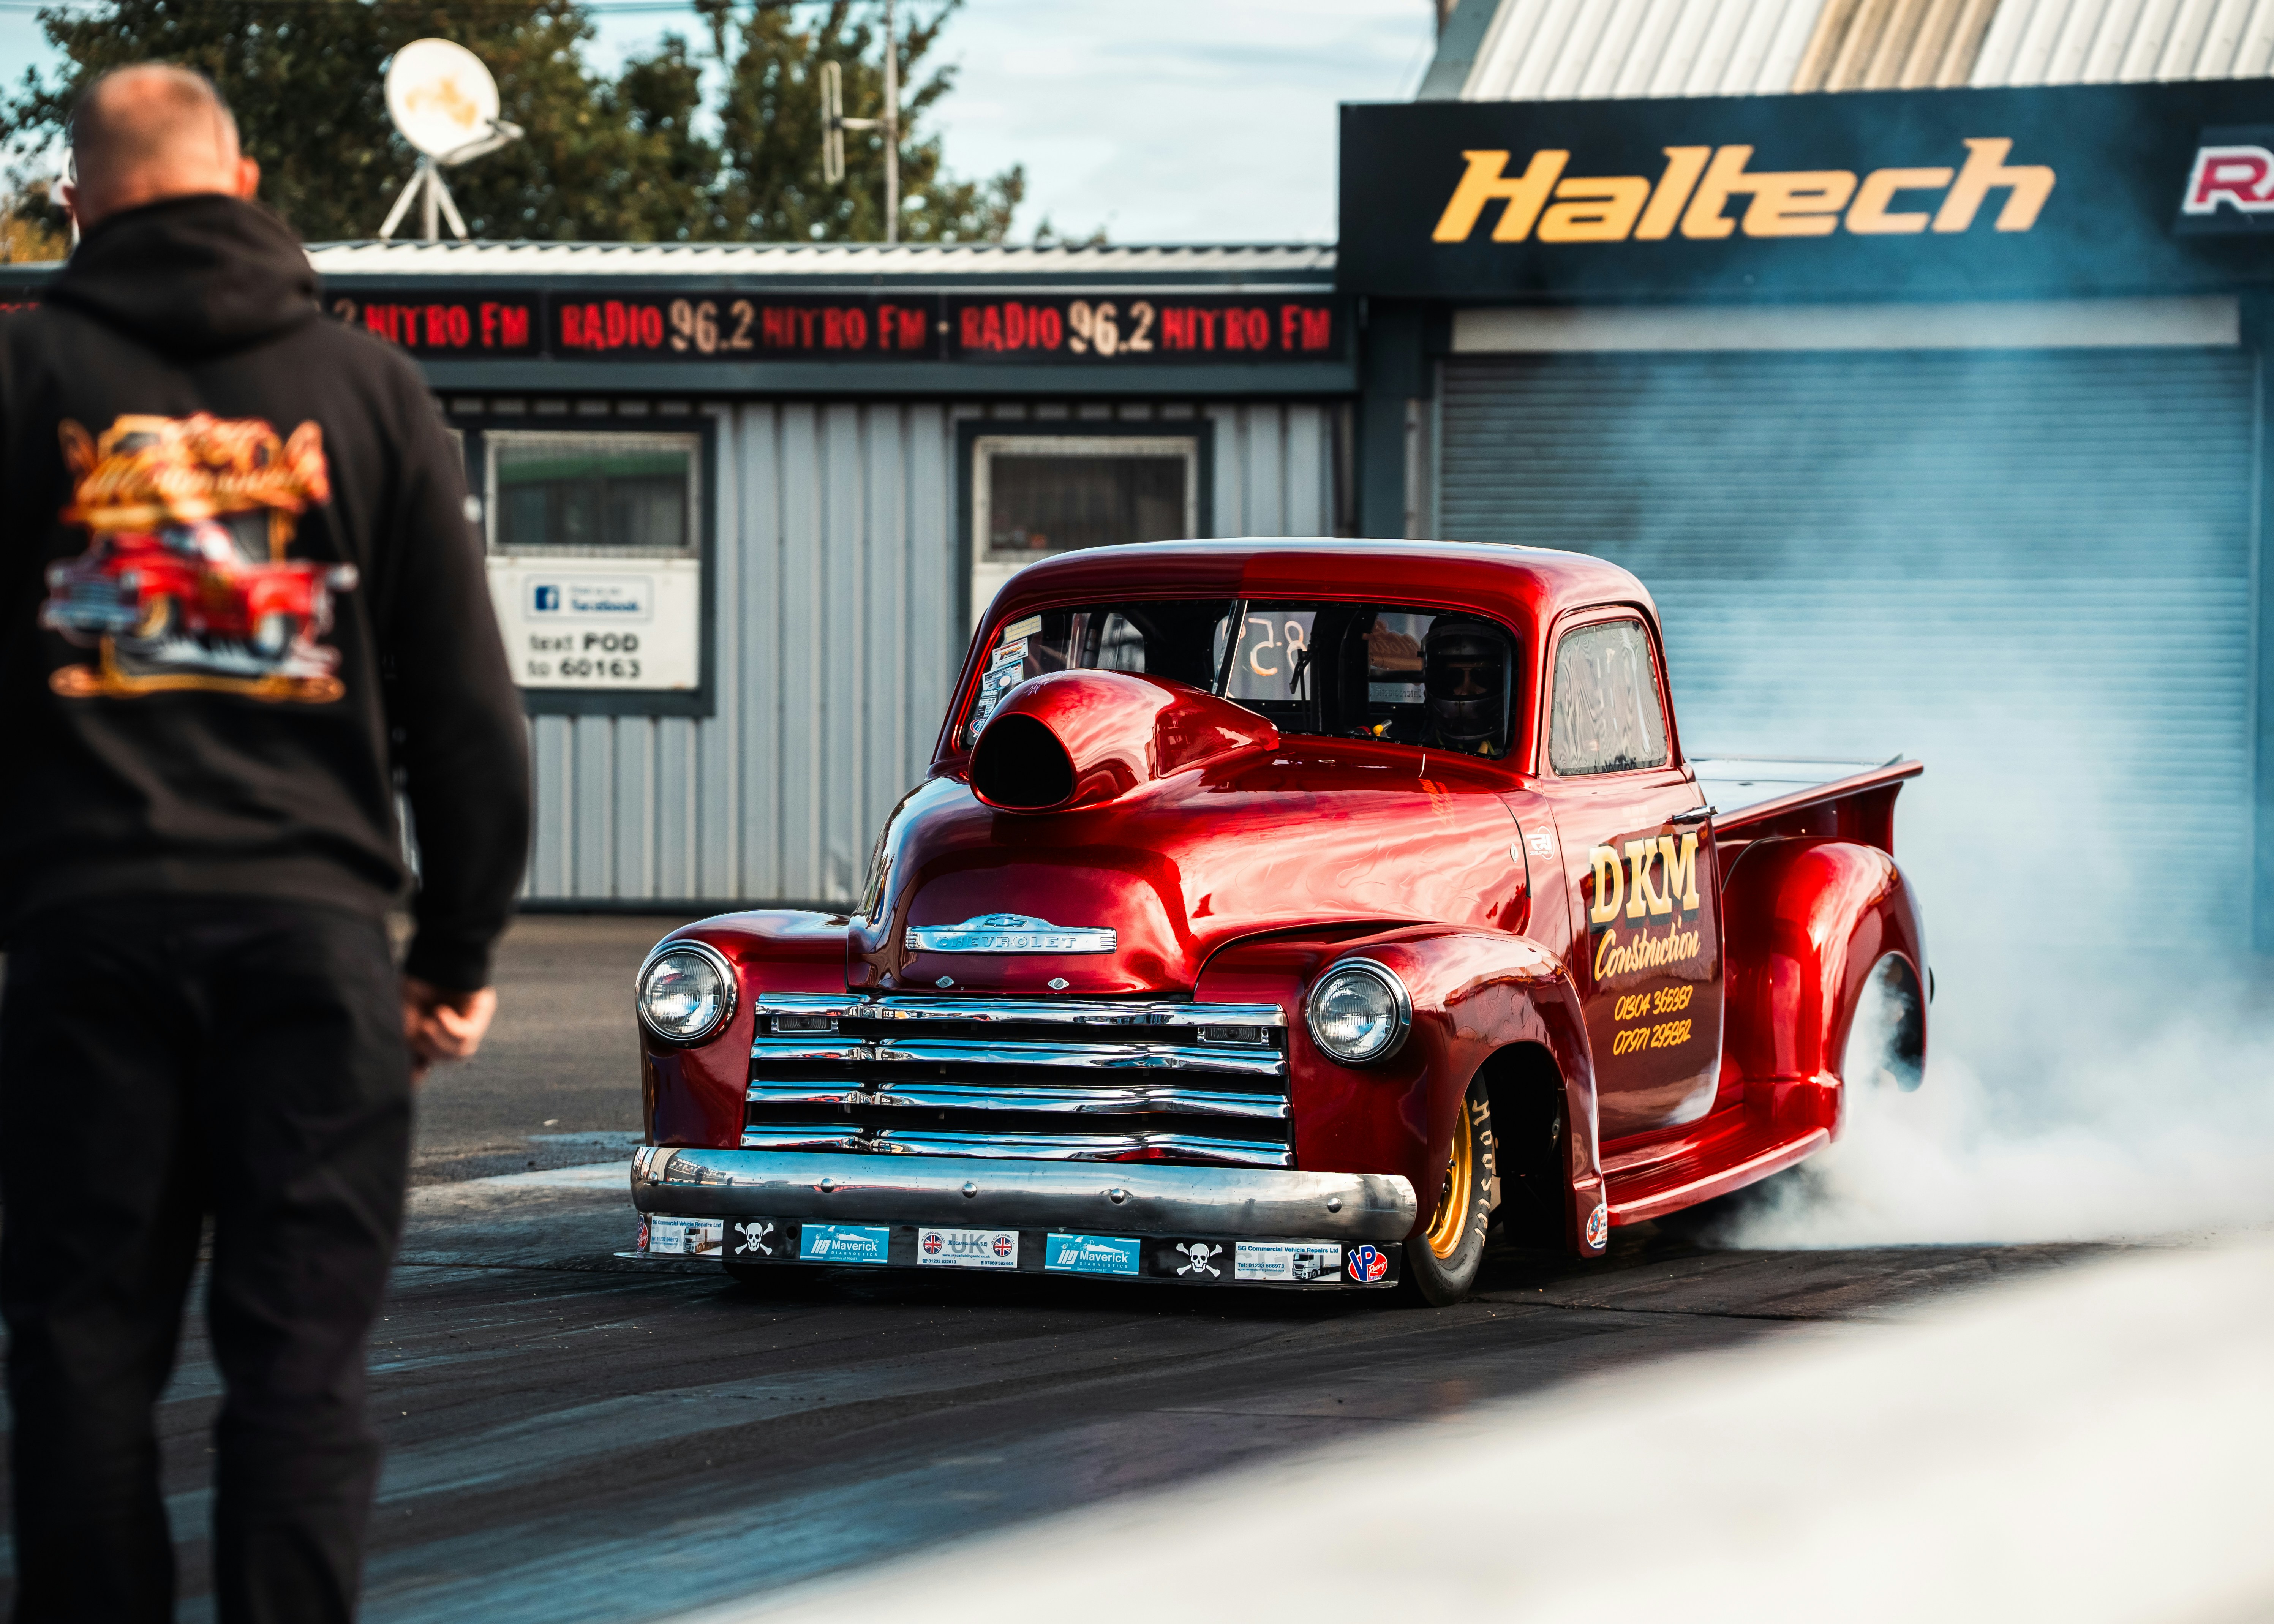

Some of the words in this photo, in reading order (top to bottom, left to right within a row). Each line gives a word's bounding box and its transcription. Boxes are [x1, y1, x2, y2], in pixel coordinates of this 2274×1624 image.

[1431, 137, 2056, 243] Haltech
[2181, 145, 2274, 215] R
[480, 301, 528, 348] FM
[669, 299, 755, 355] 96.2
[762, 306, 867, 349] NITRO
[879, 305, 926, 350] FM
[1068, 300, 1155, 357] 96.2
[1161, 308, 1269, 351] NITRO
[1281, 305, 1330, 351] FM
[530, 633, 573, 651] text
[583, 632, 639, 652] POD
[528, 659, 550, 676] to
[560, 658, 641, 679] 60163
[1589, 833, 1700, 923] DKM
[936, 936, 1076, 948] CHEVROLET
[1594, 915, 1700, 981] Construction
[1615, 993, 1651, 1021] 01304
[1653, 985, 1693, 1014] 365387
[1613, 1027, 1650, 1055] 07971
[1651, 1018, 1691, 1048] 295852
[832, 1240, 877, 1251] Maverick
[951, 1234, 985, 1254] UK
[1080, 1251, 1128, 1263] Maverick
[1348, 1245, 1377, 1282] VP
[1369, 1261, 1387, 1276] Racing
